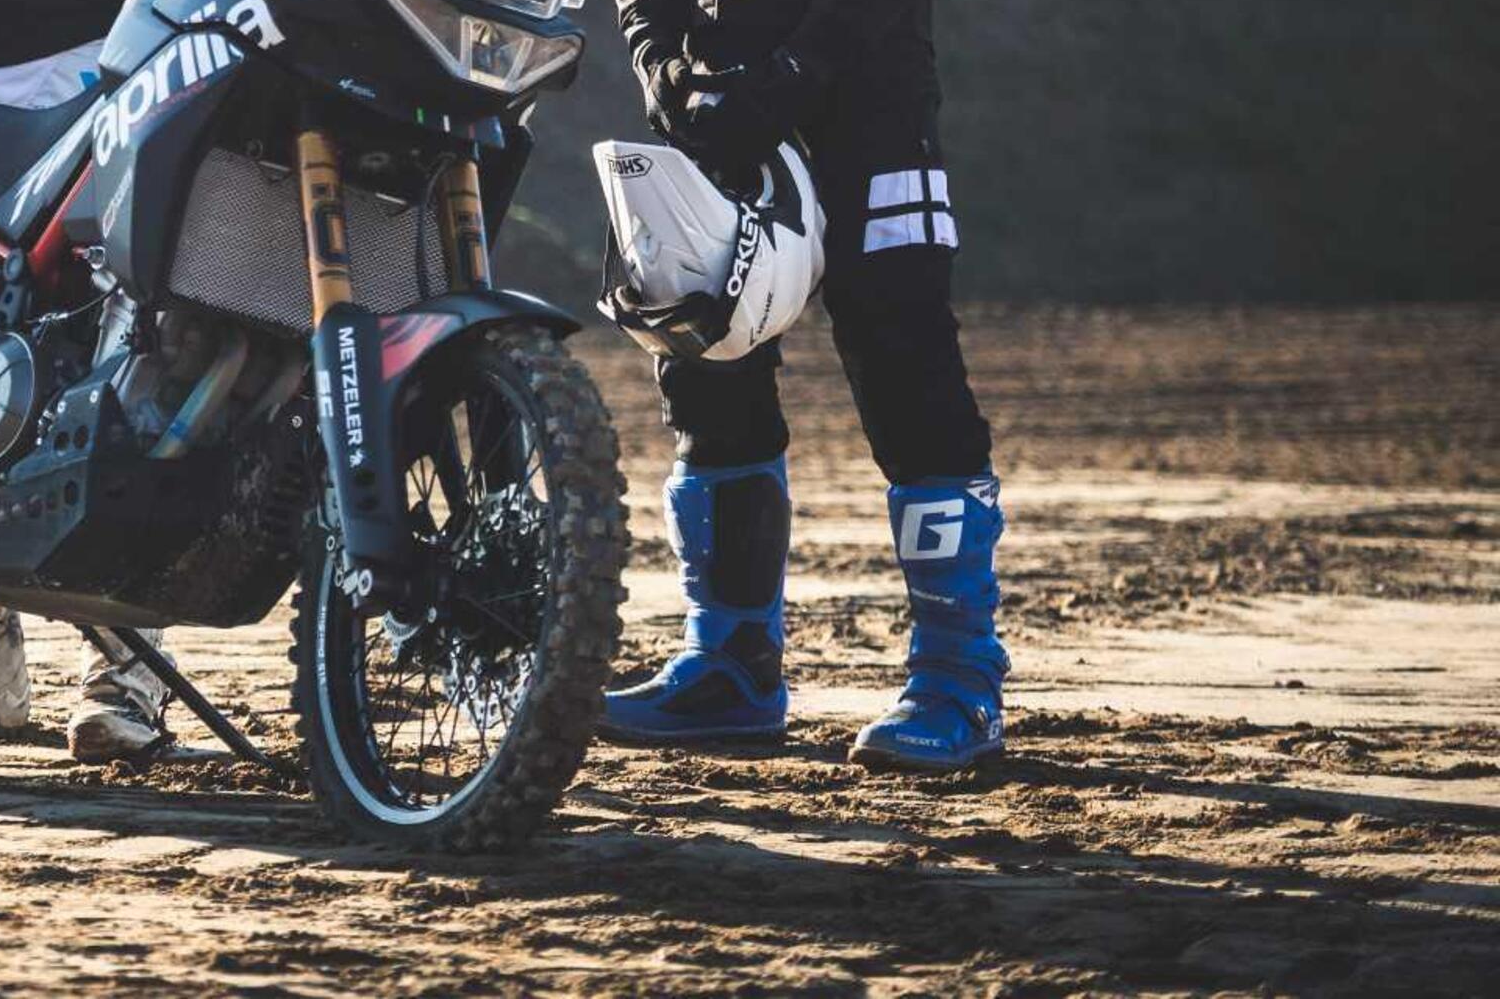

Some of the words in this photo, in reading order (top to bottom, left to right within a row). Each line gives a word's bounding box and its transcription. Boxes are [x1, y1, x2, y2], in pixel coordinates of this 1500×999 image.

[607, 157, 645, 175] SHO
[726, 201, 760, 298] OAKLEY
[338, 326, 363, 447] METZELER
[900, 499, 965, 560] G
